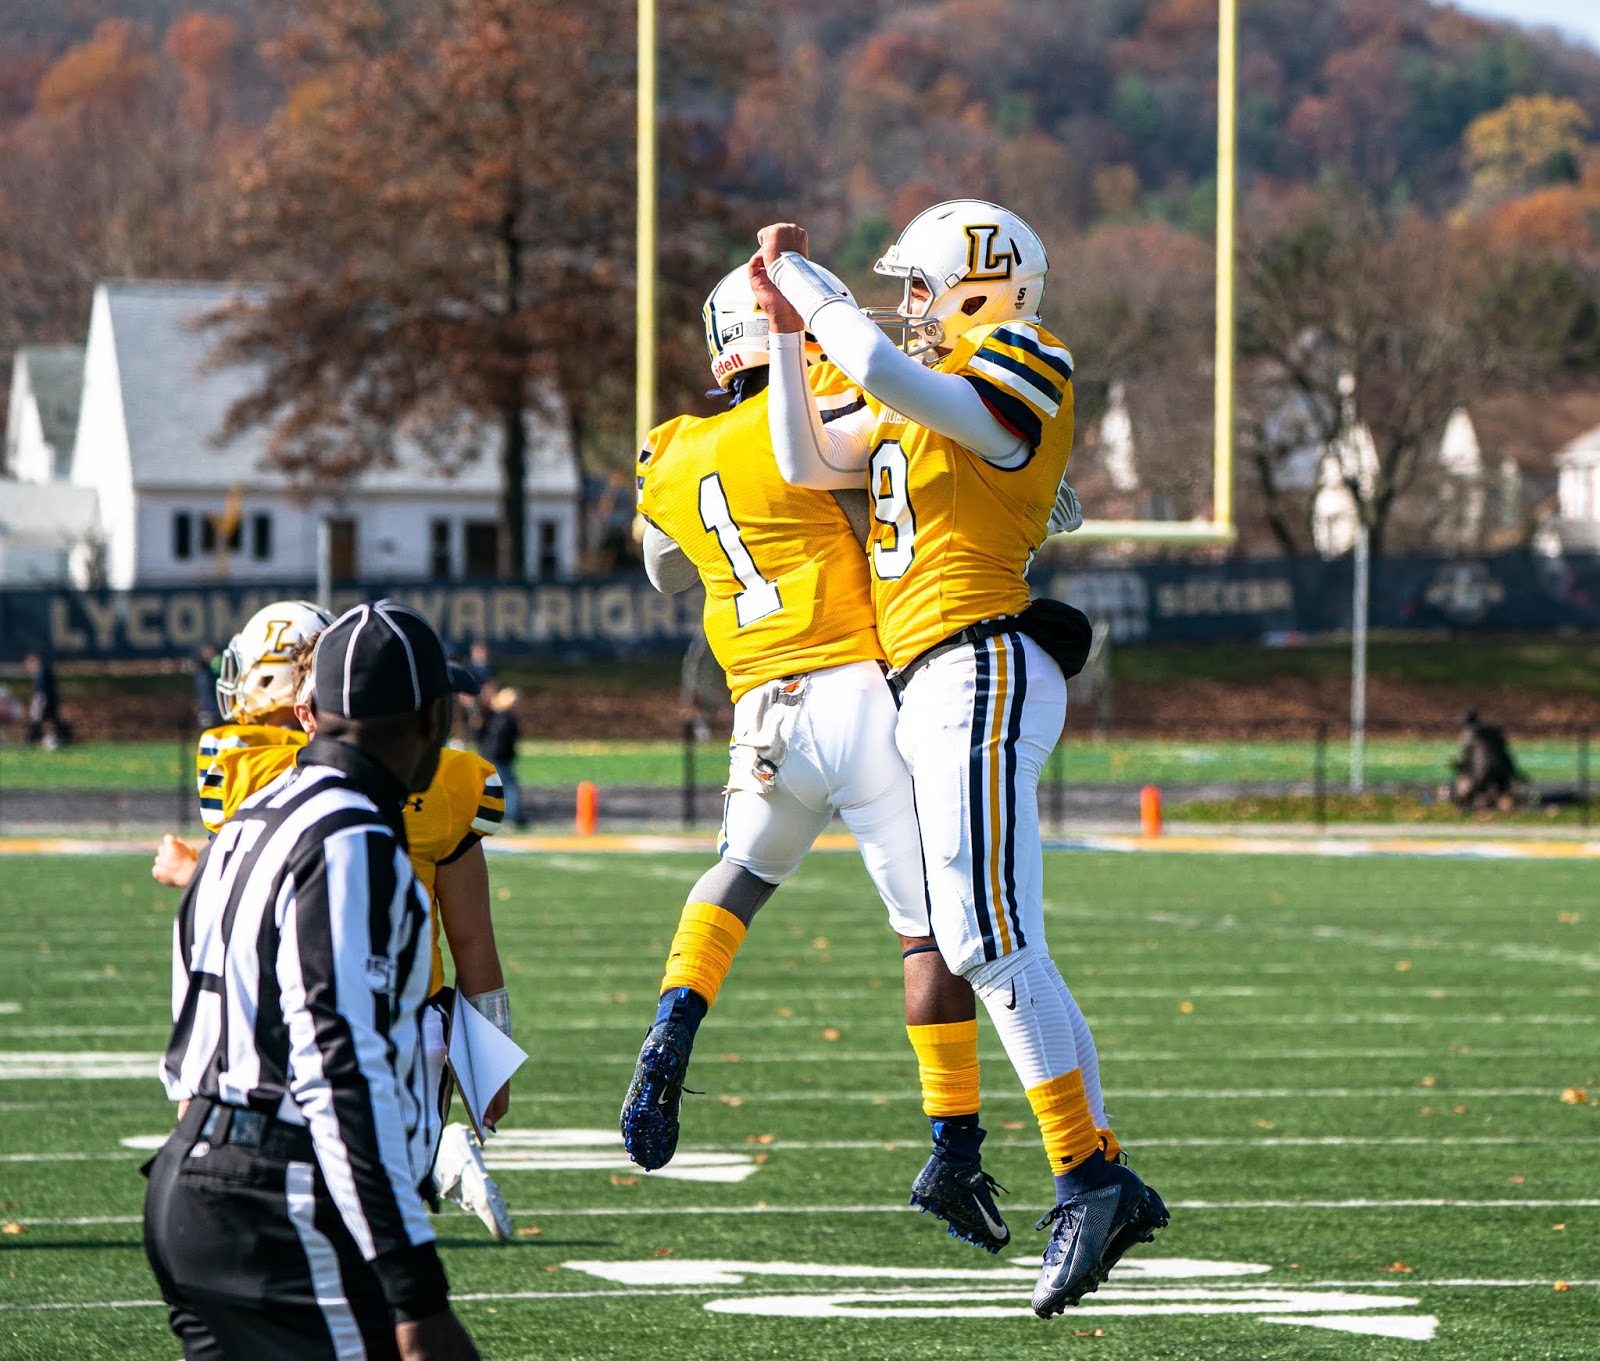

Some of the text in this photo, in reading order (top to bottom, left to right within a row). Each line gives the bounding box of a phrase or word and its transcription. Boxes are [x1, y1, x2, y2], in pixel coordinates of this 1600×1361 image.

[960, 224, 1013, 283] L
[868, 439, 917, 580] 9
[698, 470, 783, 628] 1
[52, 589, 362, 650] LYCOM
[257, 620, 297, 664] L
